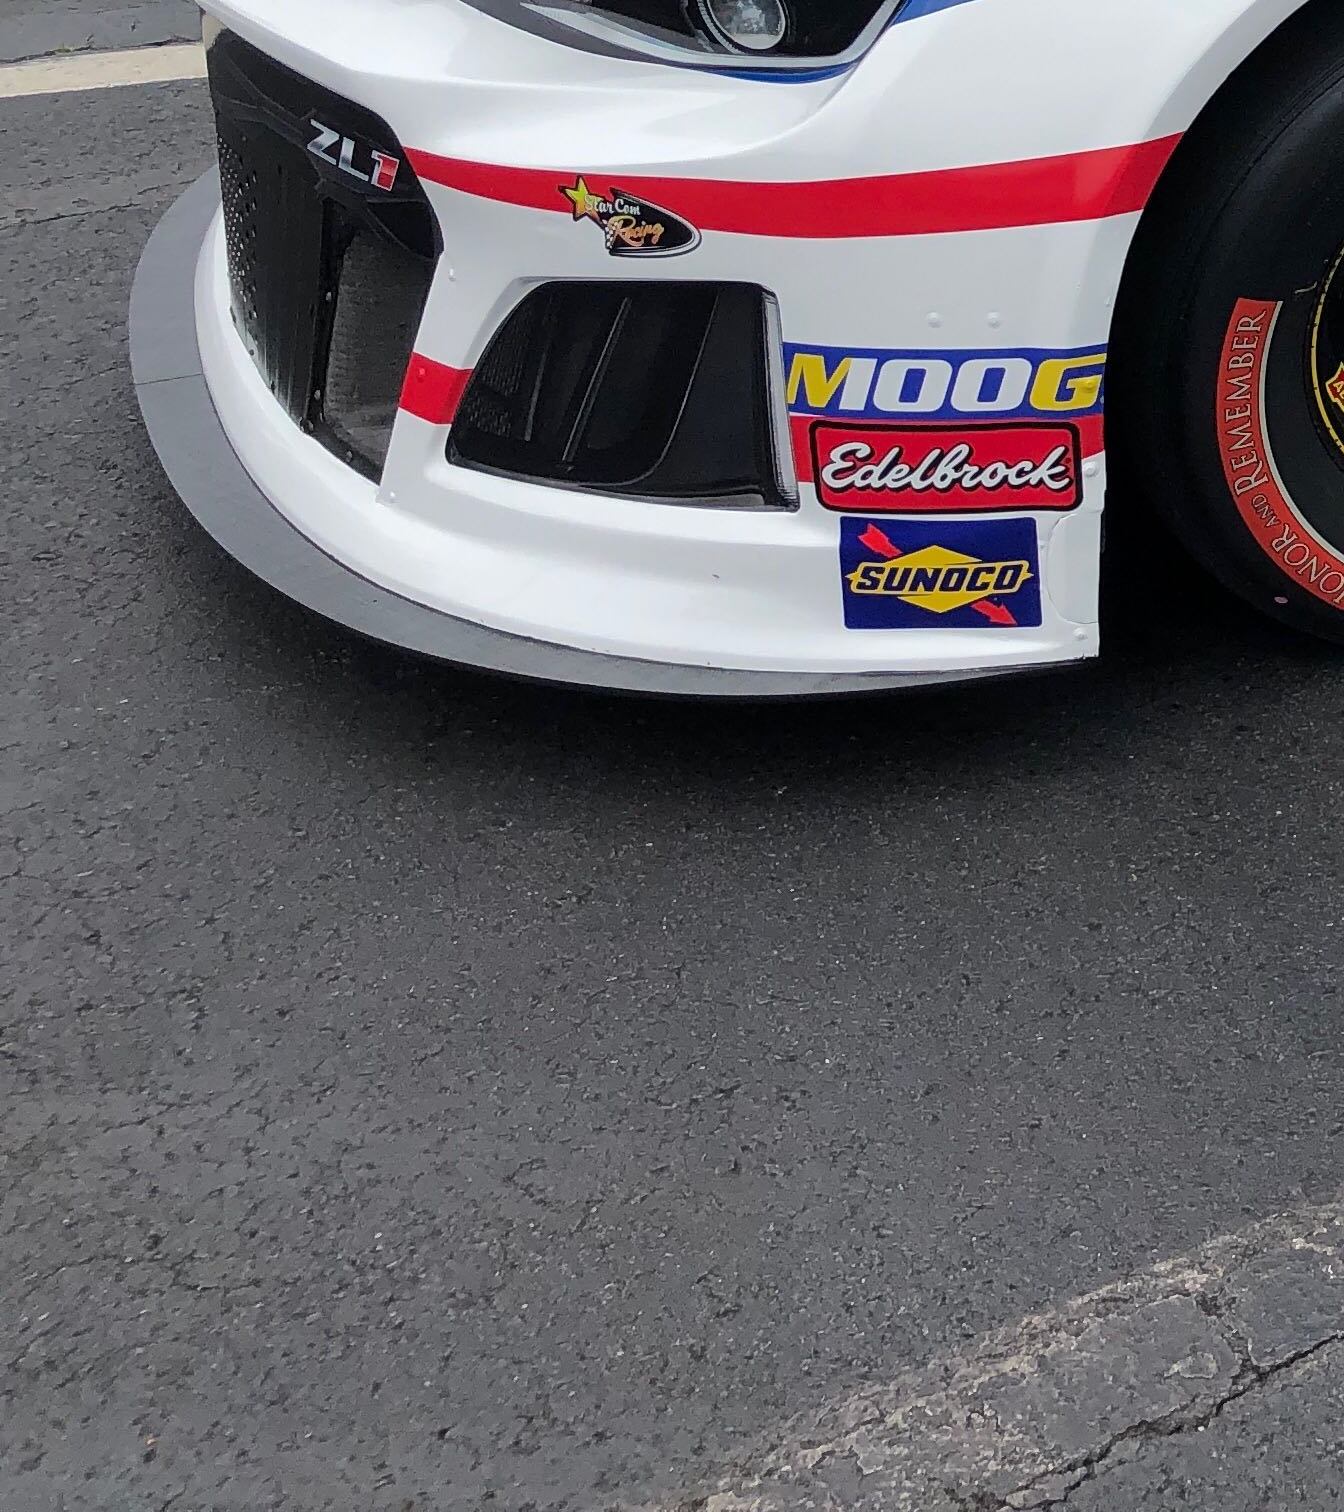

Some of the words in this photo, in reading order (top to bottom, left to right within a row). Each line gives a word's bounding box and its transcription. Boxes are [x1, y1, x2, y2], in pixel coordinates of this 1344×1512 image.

[306, 118, 400, 192] ZL1
[607, 215, 665, 248] Racing
[786, 352, 1107, 412] MOOG
[1224, 309, 1270, 497] REMEMBER
[820, 440, 1074, 491] Edelbrock
[1250, 493, 1282, 529] AND
[855, 562, 1028, 593] SUNOCO
